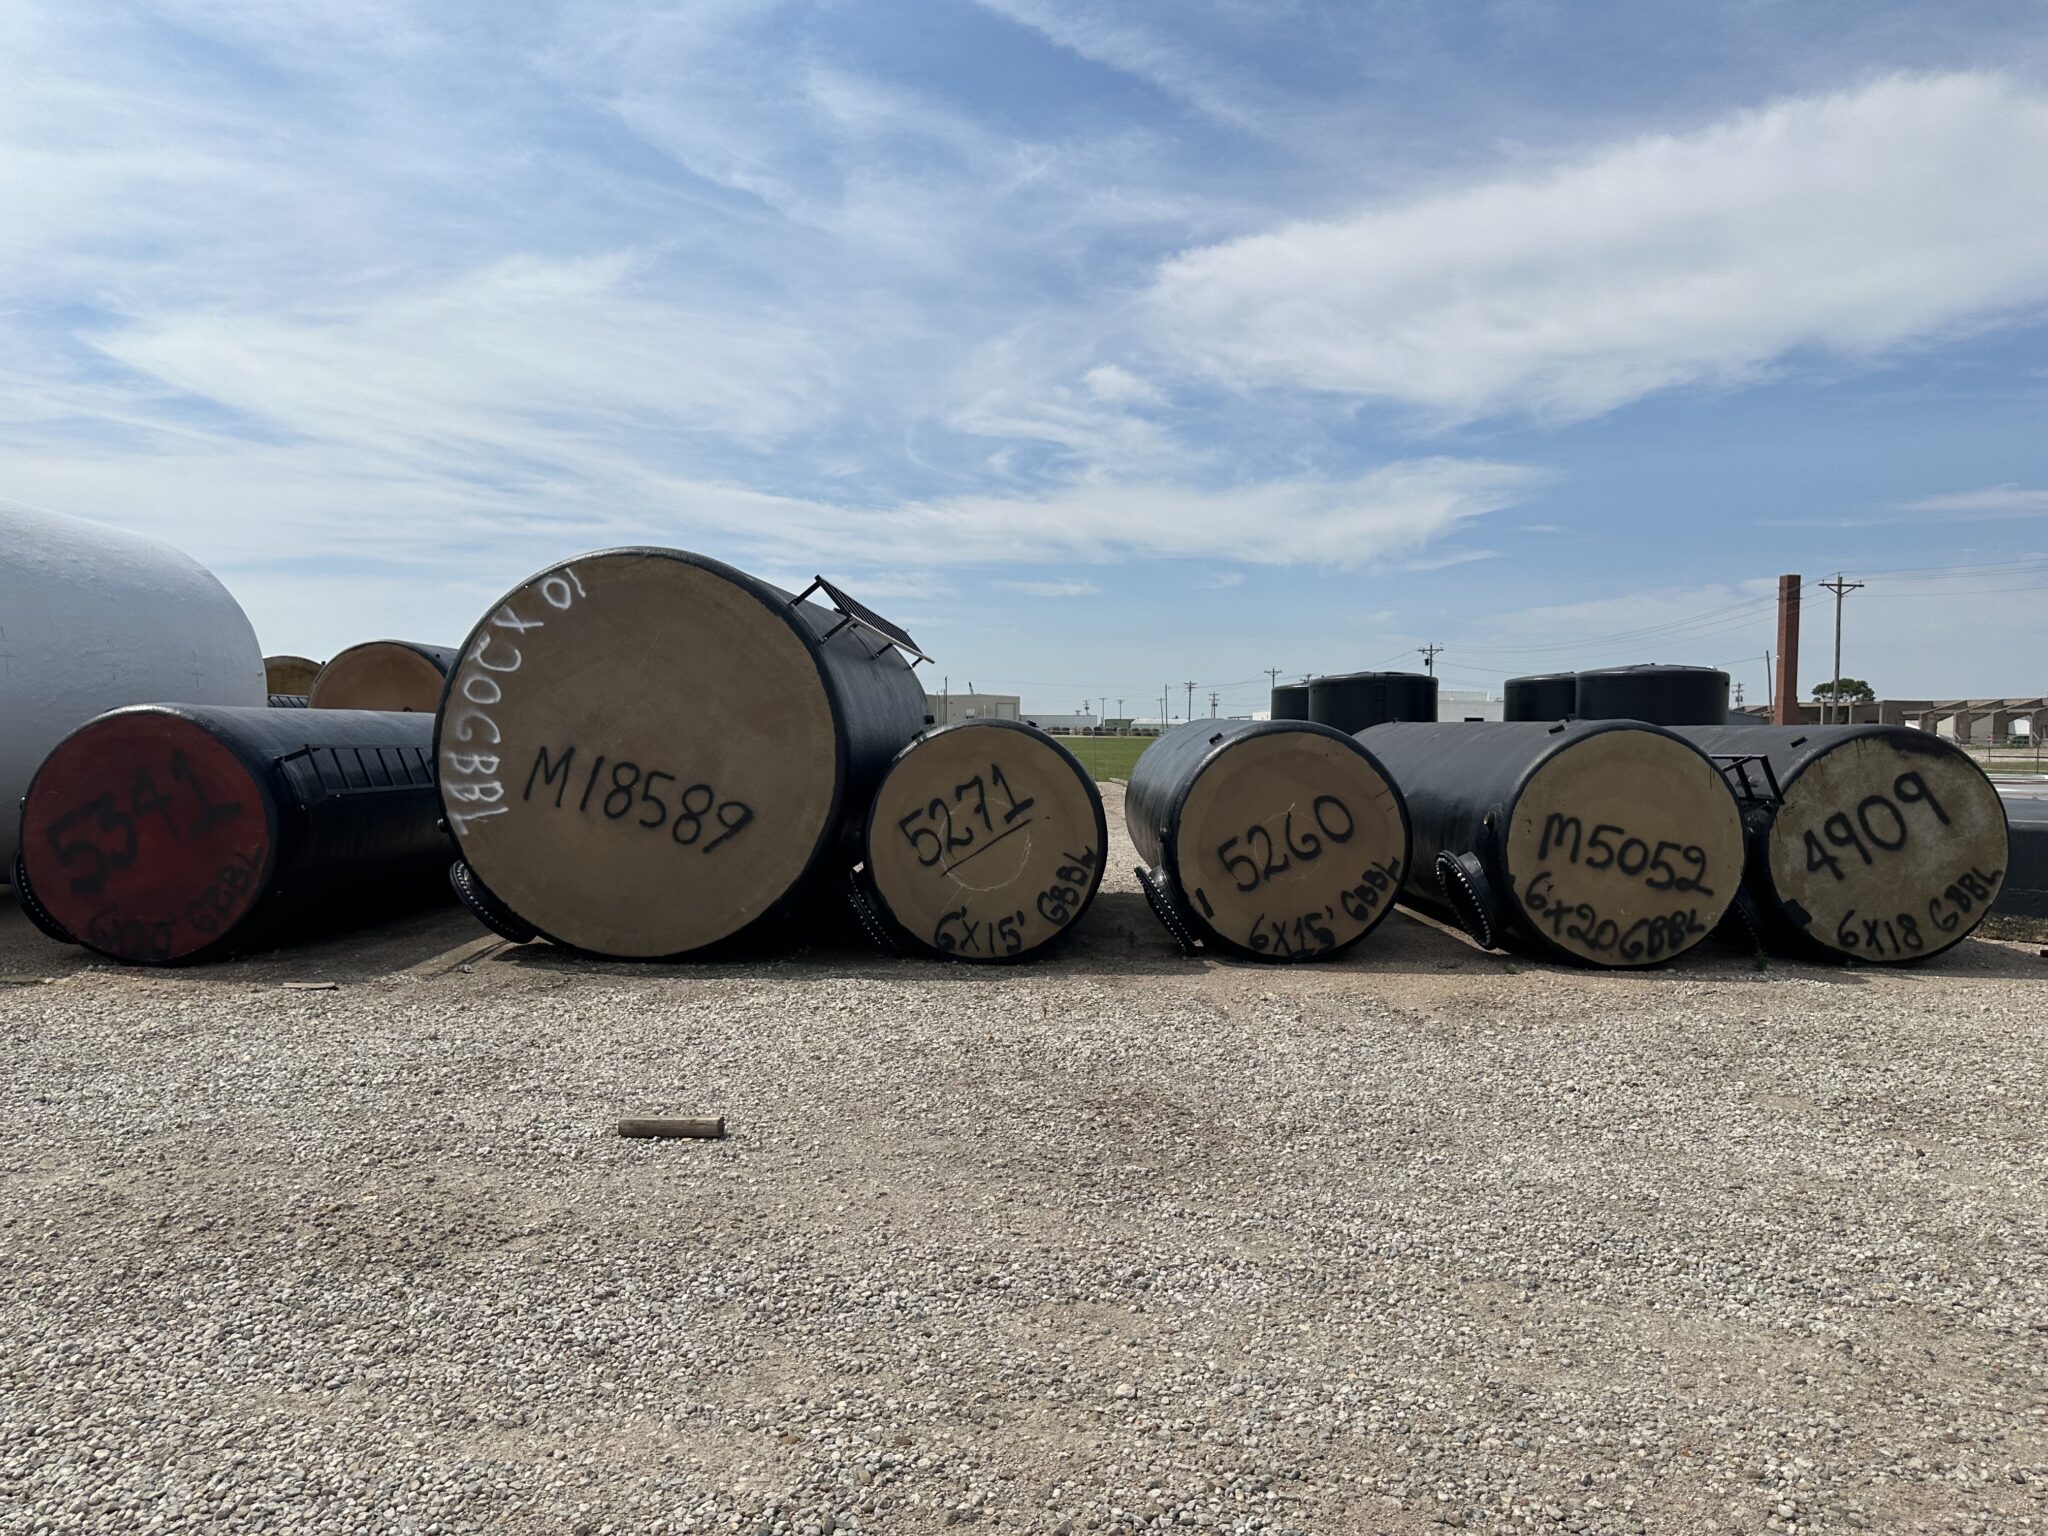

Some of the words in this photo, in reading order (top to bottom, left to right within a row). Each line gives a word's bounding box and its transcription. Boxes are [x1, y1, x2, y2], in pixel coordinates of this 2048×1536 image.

[46, 749, 242, 894] 5341
[523, 746, 754, 853] M18589
[899, 764, 1034, 866] 5271
[1217, 795, 1354, 892] 5260
[1804, 771, 1951, 881] 4909
[1538, 812, 1714, 896] M5052
[1930, 868, 2003, 932] GBBL
